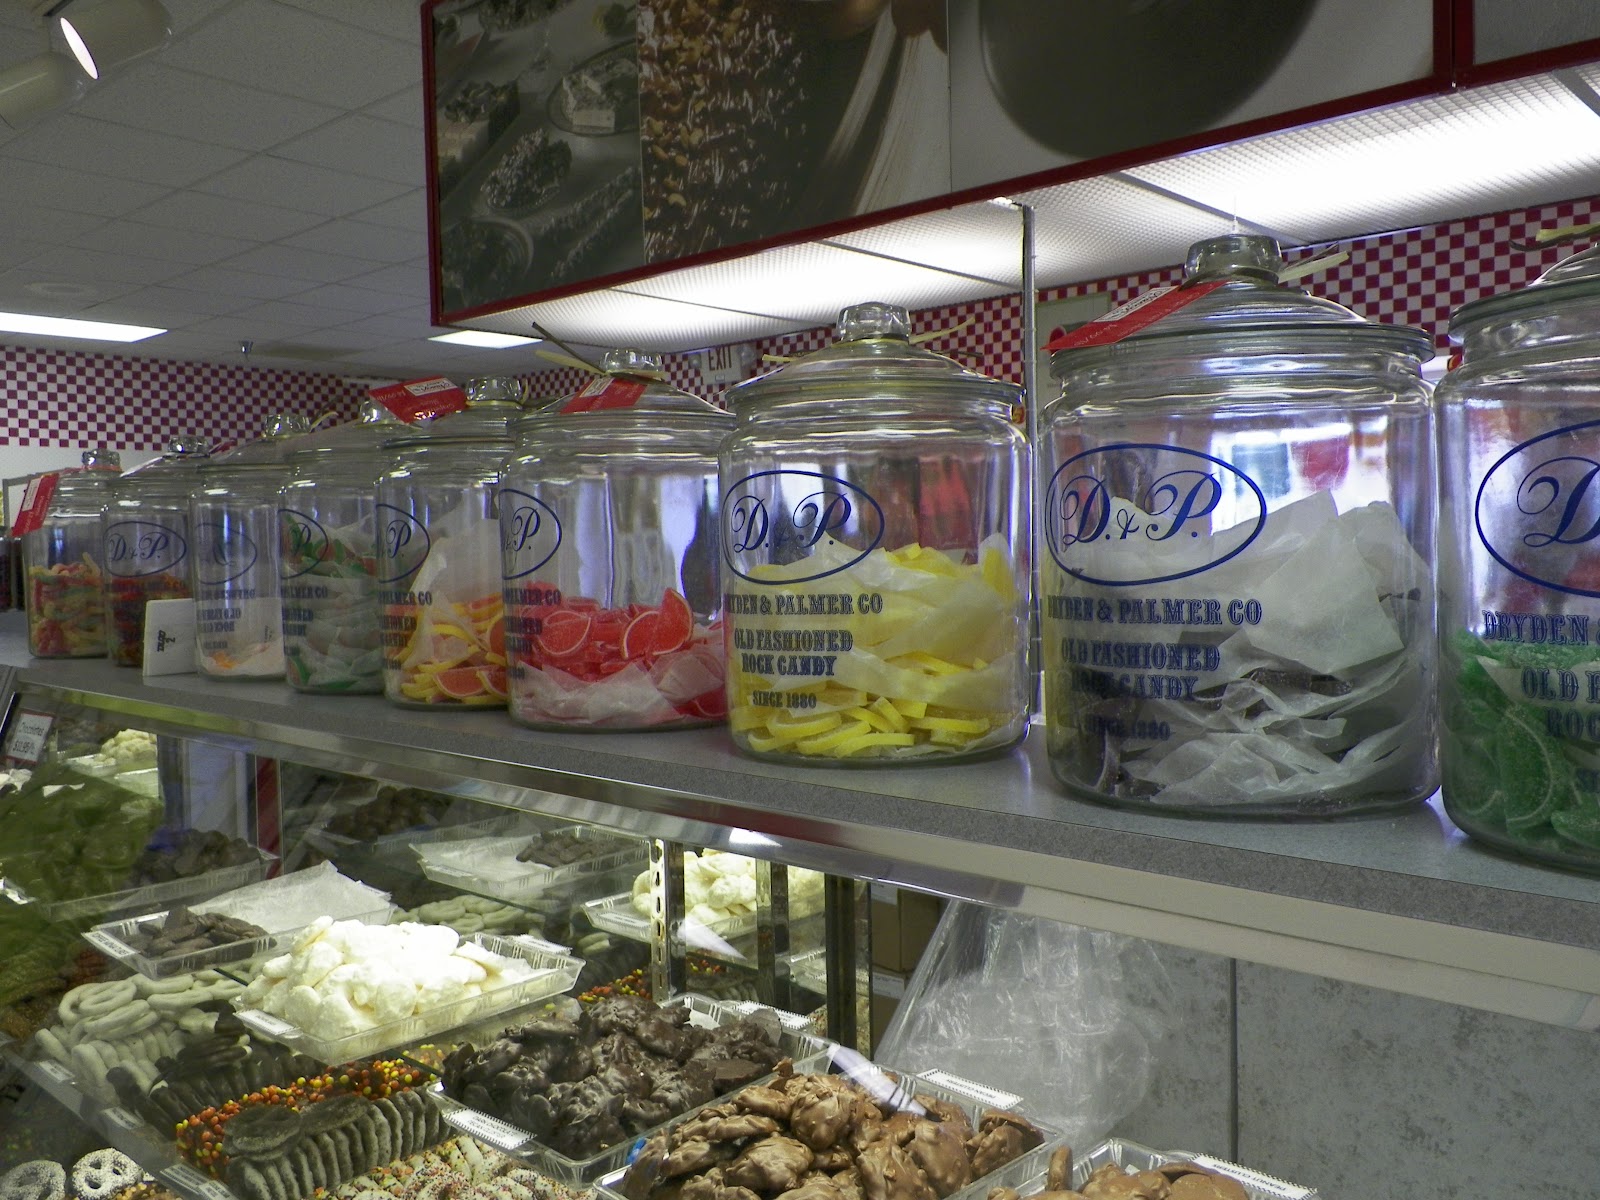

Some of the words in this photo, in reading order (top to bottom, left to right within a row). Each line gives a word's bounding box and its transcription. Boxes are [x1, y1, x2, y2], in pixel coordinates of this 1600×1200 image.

[708, 345, 732, 371] EXIT
[760, 594, 773, 616] &
[775, 593, 855, 616] PALMER
[857, 592, 884, 615] CO
[1097, 598, 1113, 624] &
[1117, 598, 1223, 625] PALMER
[1226, 598, 1263, 625] CO
[734, 627, 755, 650] OLD
[756, 629, 854, 652] FASHIONED
[1482, 609, 1590, 646] DRYDEN
[741, 652, 775, 675] ROCK
[776, 654, 837, 676] CANDY
[1061, 637, 1089, 664] OLD
[1091, 640, 1220, 672] FASHIONED
[1118, 673, 1200, 701] CANDY
[1520, 665, 1579, 702] OLD
[752, 690, 783, 708] SINCE
[1213, 1163, 1251, 1179] CLUSTERS
[1252, 1177, 1286, 1191] PEANUT
